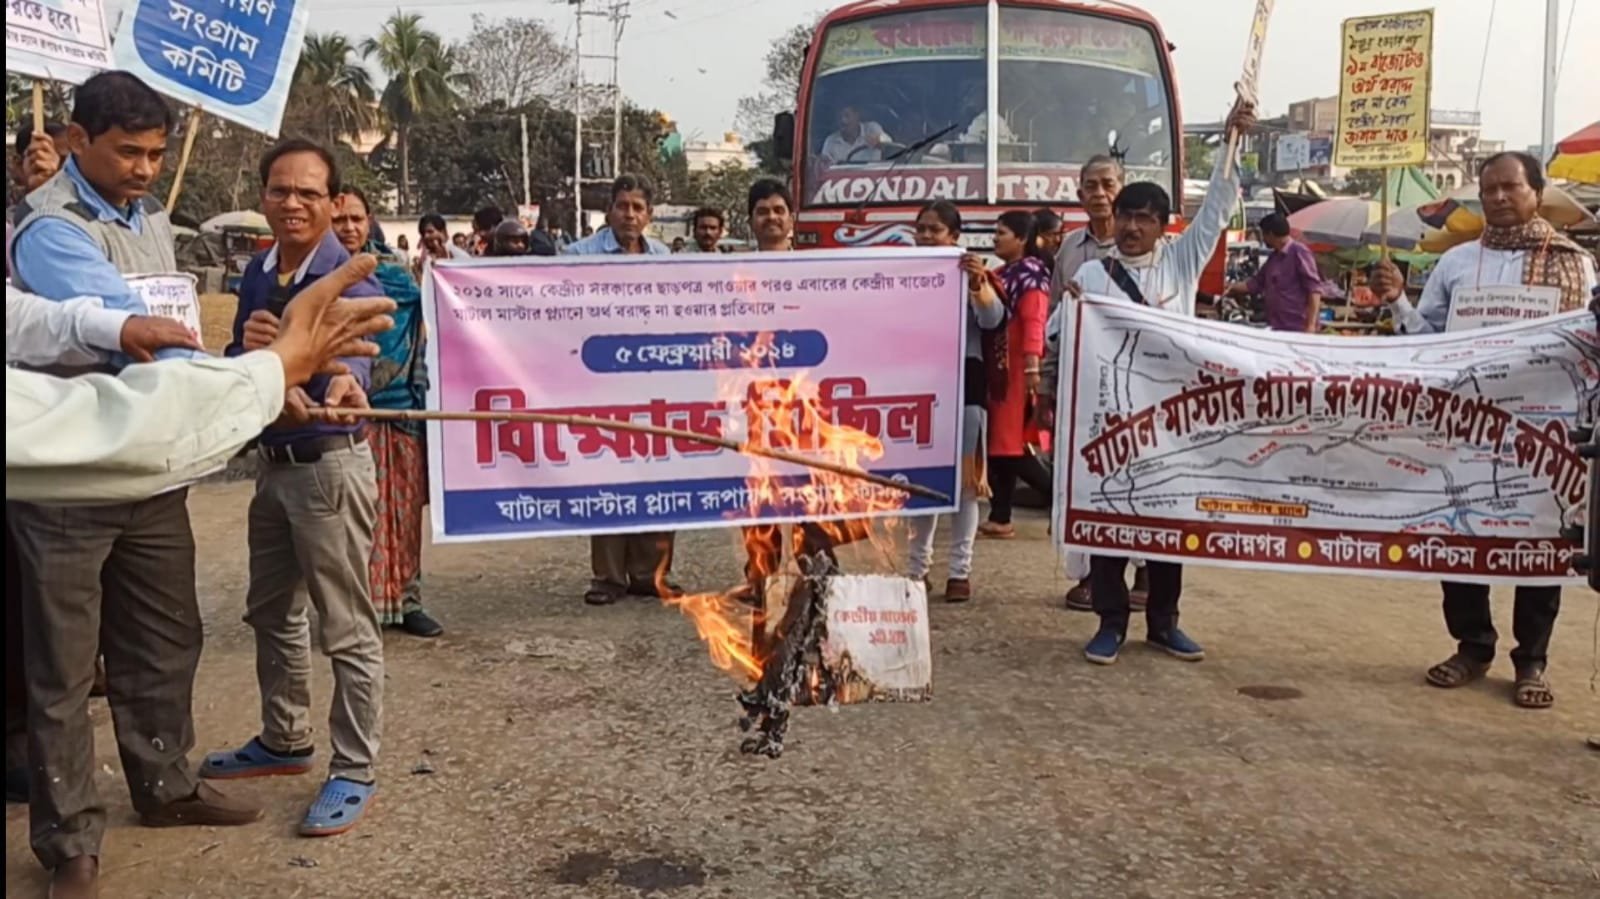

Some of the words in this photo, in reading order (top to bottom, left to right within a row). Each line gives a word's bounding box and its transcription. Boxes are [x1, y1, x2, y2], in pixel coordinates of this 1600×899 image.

[6, 0, 42, 20] রতে
[168, 1, 259, 60] সংগ্রাম
[160, 40, 247, 91] কমিটি
[814, 174, 980, 202] MONDAL
[454, 284, 493, 298] ২০১৫
[498, 283, 534, 298] সালে
[540, 279, 585, 297] কেন্দ্রীয়
[589, 281, 653, 297] সরকারের
[656, 280, 702, 296] ছাড়পত্র
[761, 279, 793, 293] পরও
[797, 278, 847, 293] এবারের
[852, 272, 894, 291] কেন্দ্রীয়
[899, 272, 946, 290] বাজেটে
[453, 305, 493, 322] ঘাটাল
[497, 305, 541, 321] মাস্টার
[544, 307, 583, 321] প্ল্যানে
[587, 303, 612, 319] অর্থ
[614, 305, 651, 320] বরাদ্দ
[655, 305, 669, 317] না
[674, 304, 717, 319] হওয়ার
[720, 299, 775, 317] প্রতিবাদে
[615, 347, 631, 363] ৫
[637, 336, 731, 365] ফেব্রুয়ারী
[469, 388, 727, 464] বিক্ষোভ
[1080, 404, 1157, 477] ঘাটাল
[1161, 370, 1245, 437] মাস্টার
[1253, 371, 1315, 419] প্ল্যান
[1322, 372, 1423, 425] রূপায়ণ
[1425, 386, 1512, 455] সংগ্রাম
[496, 494, 560, 521] ঘাটাল
[568, 490, 637, 517] মাস্টার
[645, 490, 692, 515] প্ল্যান
[1072, 520, 1183, 550] দেবেন্দ্রভবন
[1206, 530, 1287, 558] কোন্নগর
[1317, 533, 1382, 563] ঘাটাল
[1408, 537, 1477, 568] পশ্চিম
[1486, 540, 1585, 577] মেদিনীপু
